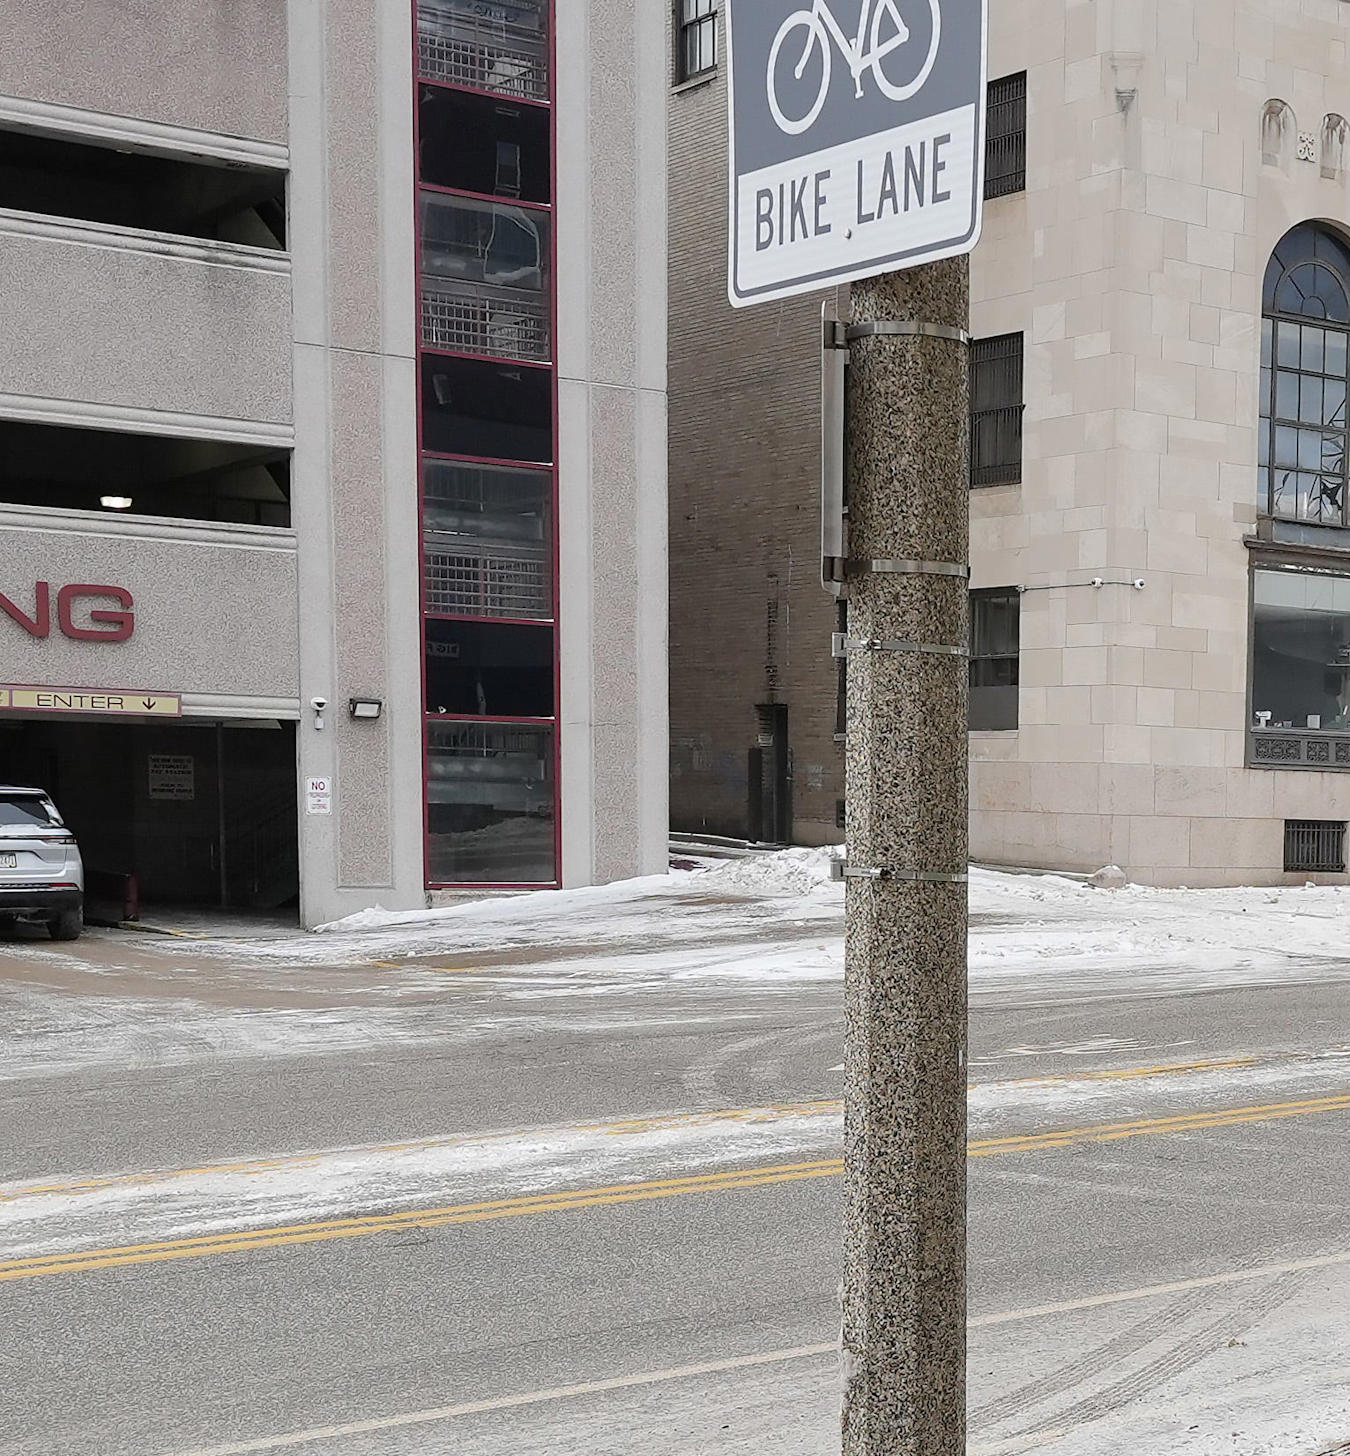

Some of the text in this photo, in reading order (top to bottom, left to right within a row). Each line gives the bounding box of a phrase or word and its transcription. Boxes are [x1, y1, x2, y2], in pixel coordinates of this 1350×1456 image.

[756, 133, 951, 252] BIKE LANE
[36, 694, 124, 709] ENTER
[312, 781, 325, 790] NO
